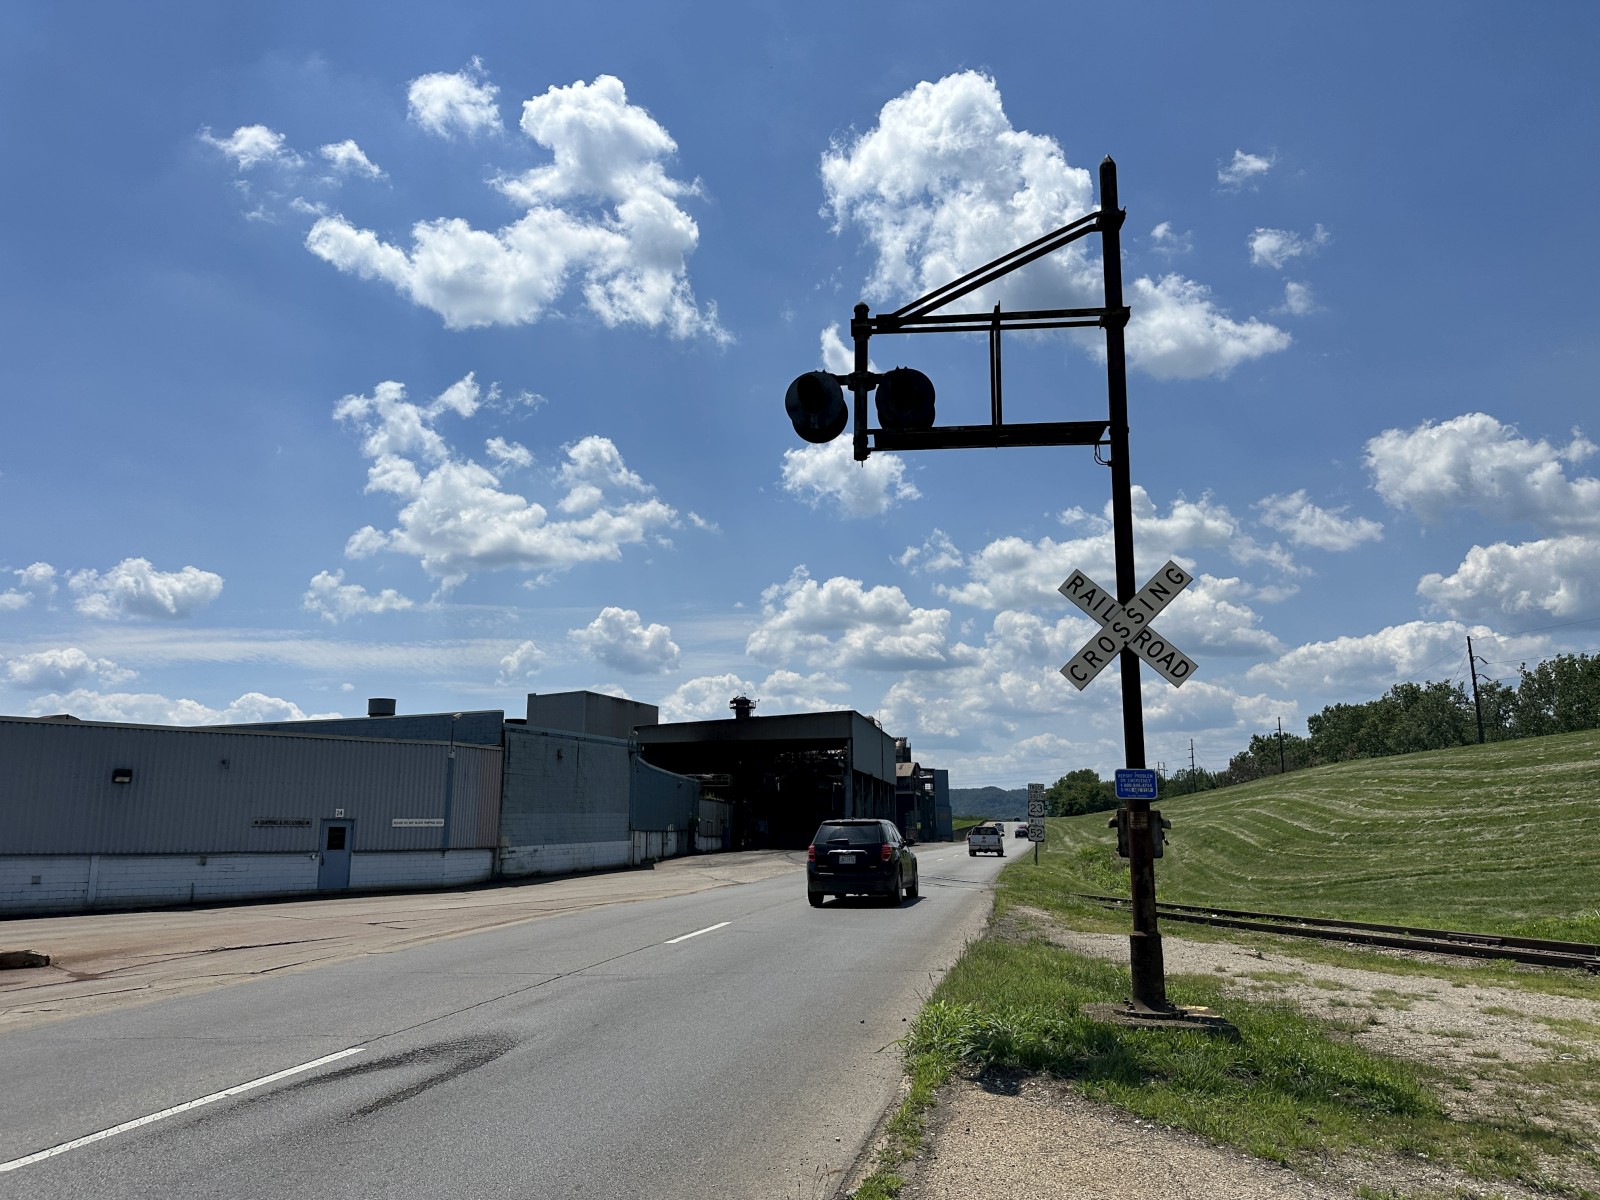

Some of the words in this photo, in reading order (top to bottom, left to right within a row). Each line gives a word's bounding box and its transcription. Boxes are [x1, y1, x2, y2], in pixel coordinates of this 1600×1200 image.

[1066, 575, 1116, 622] RAIL
[1133, 629, 1189, 678] ROAD
[1070, 568, 1184, 681] CROSSING
[1030, 804, 1043, 813] 23
[1030, 829, 1043, 838] 52
